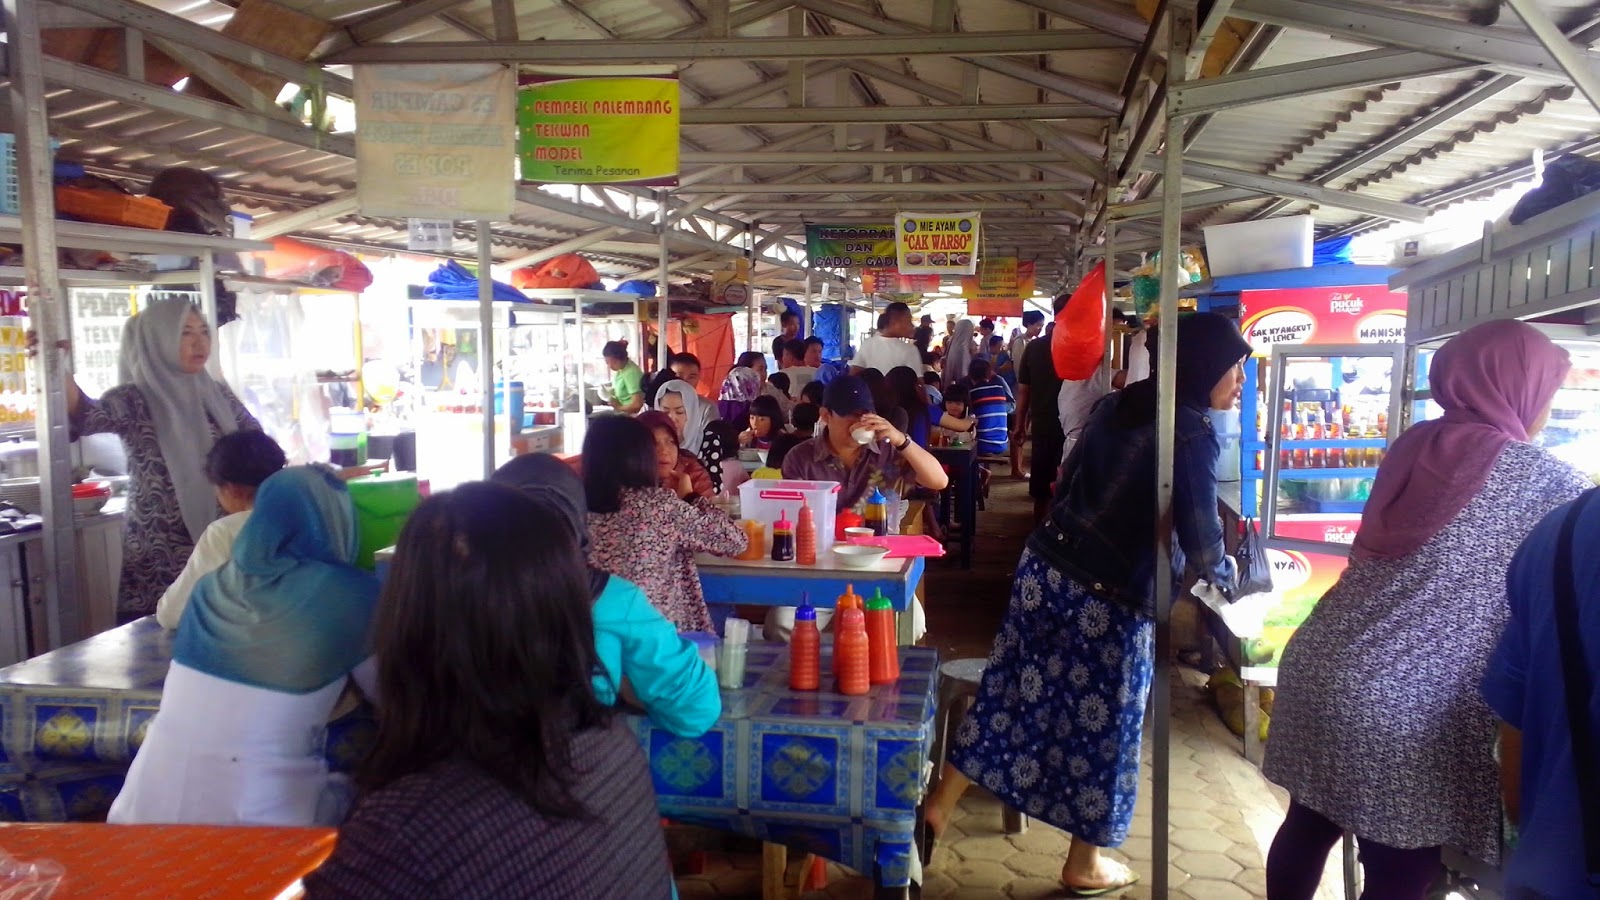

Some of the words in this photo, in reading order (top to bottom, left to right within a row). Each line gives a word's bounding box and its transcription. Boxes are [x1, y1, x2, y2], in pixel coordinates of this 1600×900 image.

[534, 100, 588, 114] PEMPEK
[593, 100, 672, 114] PALEMBANG
[535, 123, 590, 137] TEKWAN
[535, 147, 582, 160] MODEL
[553, 165, 593, 176] Terima
[595, 165, 640, 176] Pesanan
[919, 221, 934, 232] MIE
[935, 221, 956, 231] AYAM
[845, 243, 874, 252] DAN
[814, 256, 852, 267] GADO
[1251, 329, 1267, 337] GAK
[1269, 323, 1312, 335] NYANGKUT
[1360, 327, 1407, 338] MANISNY
